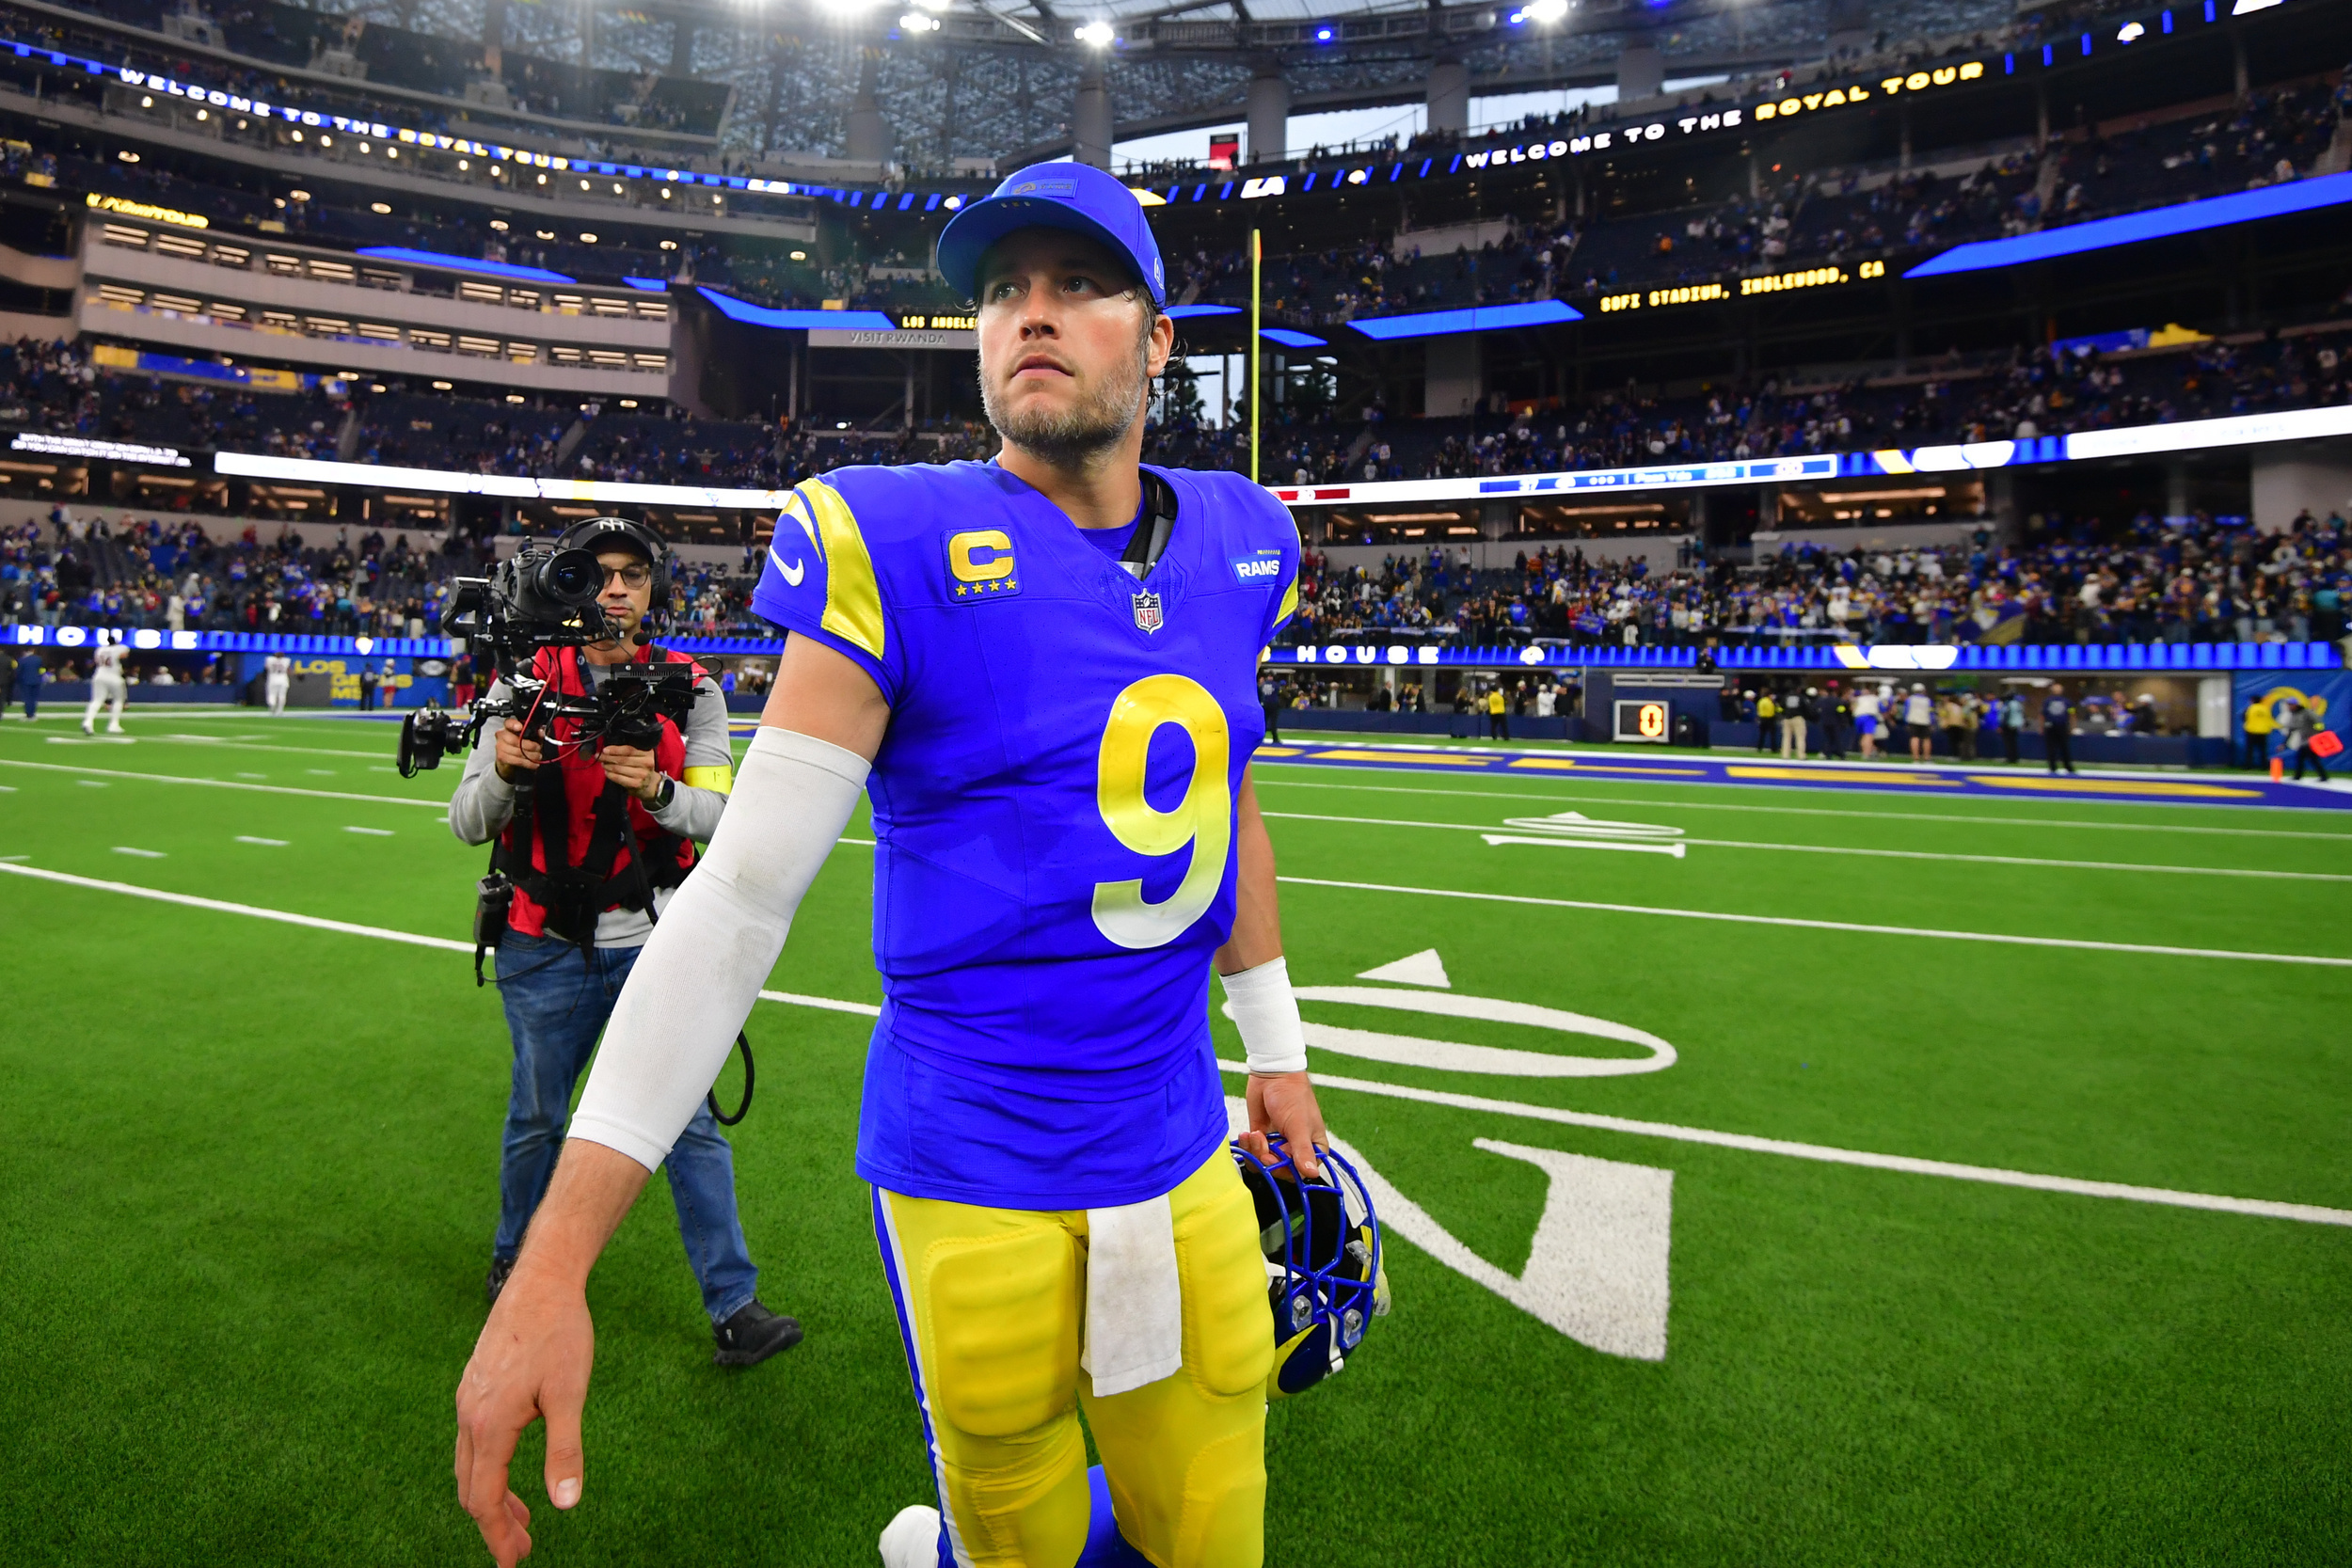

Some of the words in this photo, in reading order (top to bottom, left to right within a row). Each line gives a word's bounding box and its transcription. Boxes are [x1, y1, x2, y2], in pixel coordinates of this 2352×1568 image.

[119, 68, 271, 117] WELCOME
[284, 107, 321, 126] TO
[333, 116, 389, 138] THE
[399, 128, 488, 157] ROYAL
[499, 147, 568, 170] TOUR
[1466, 133, 1612, 168] WELCOME
[1624, 123, 1665, 143] TO
[1678, 109, 1741, 134] THE
[1755, 85, 1870, 120] ROYAL
[1881, 61, 1983, 94] TOUR
[1600, 293, 1641, 312] SOFI
[1859, 260, 1885, 278] CA
[902, 316, 925, 328] LOS
[850, 332, 884, 344] VISIT
[886, 332, 947, 345] RWANDA
[948, 530, 1014, 582] C
[1235, 560, 1280, 578] RAMS
[1138, 610, 1159, 626] NFL
[17, 625, 198, 650] HOUSE
[1296, 645, 1439, 664] HOUSE
[1640, 704, 1663, 737] 0
[1091, 673, 1231, 948] 9
